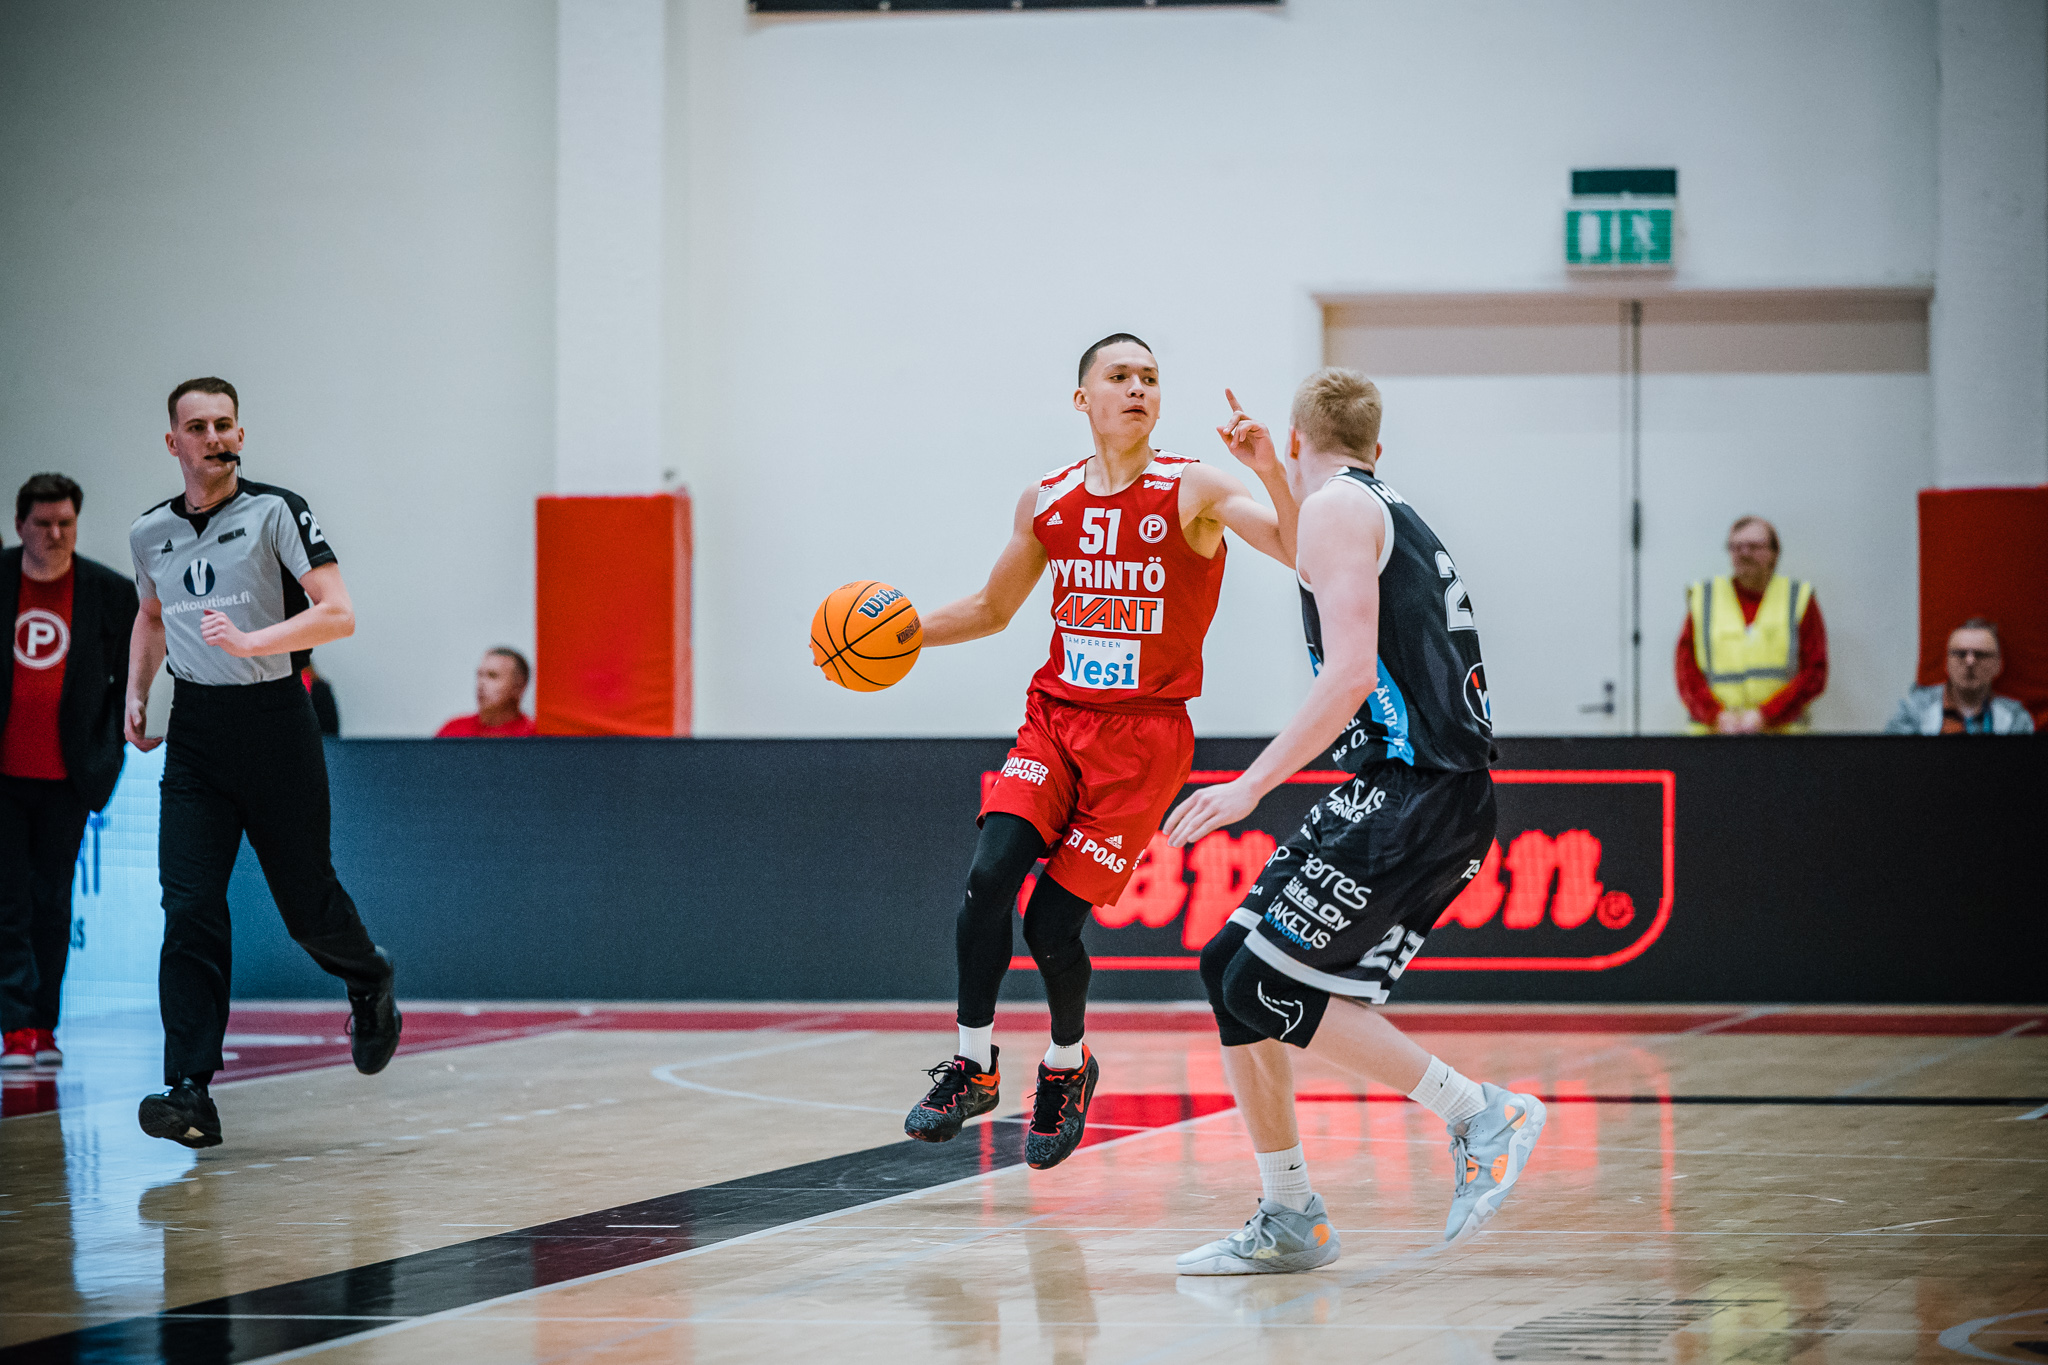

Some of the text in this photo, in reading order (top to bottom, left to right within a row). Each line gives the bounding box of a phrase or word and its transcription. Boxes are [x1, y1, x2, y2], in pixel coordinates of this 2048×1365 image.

[1079, 507, 1122, 555] 51
[1051, 556, 1166, 592] PYRINTÖ
[1055, 595, 1158, 632] AVANT
[1064, 635, 1121, 648] TAMPEREEN
[1066, 649, 1135, 687] Vesi
[1003, 767, 1047, 786] SPORT
[1008, 756, 1050, 778] INTER
[1080, 838, 1127, 874] POAS
[1319, 903, 1352, 932] Oy
[1357, 924, 1426, 982] 23
